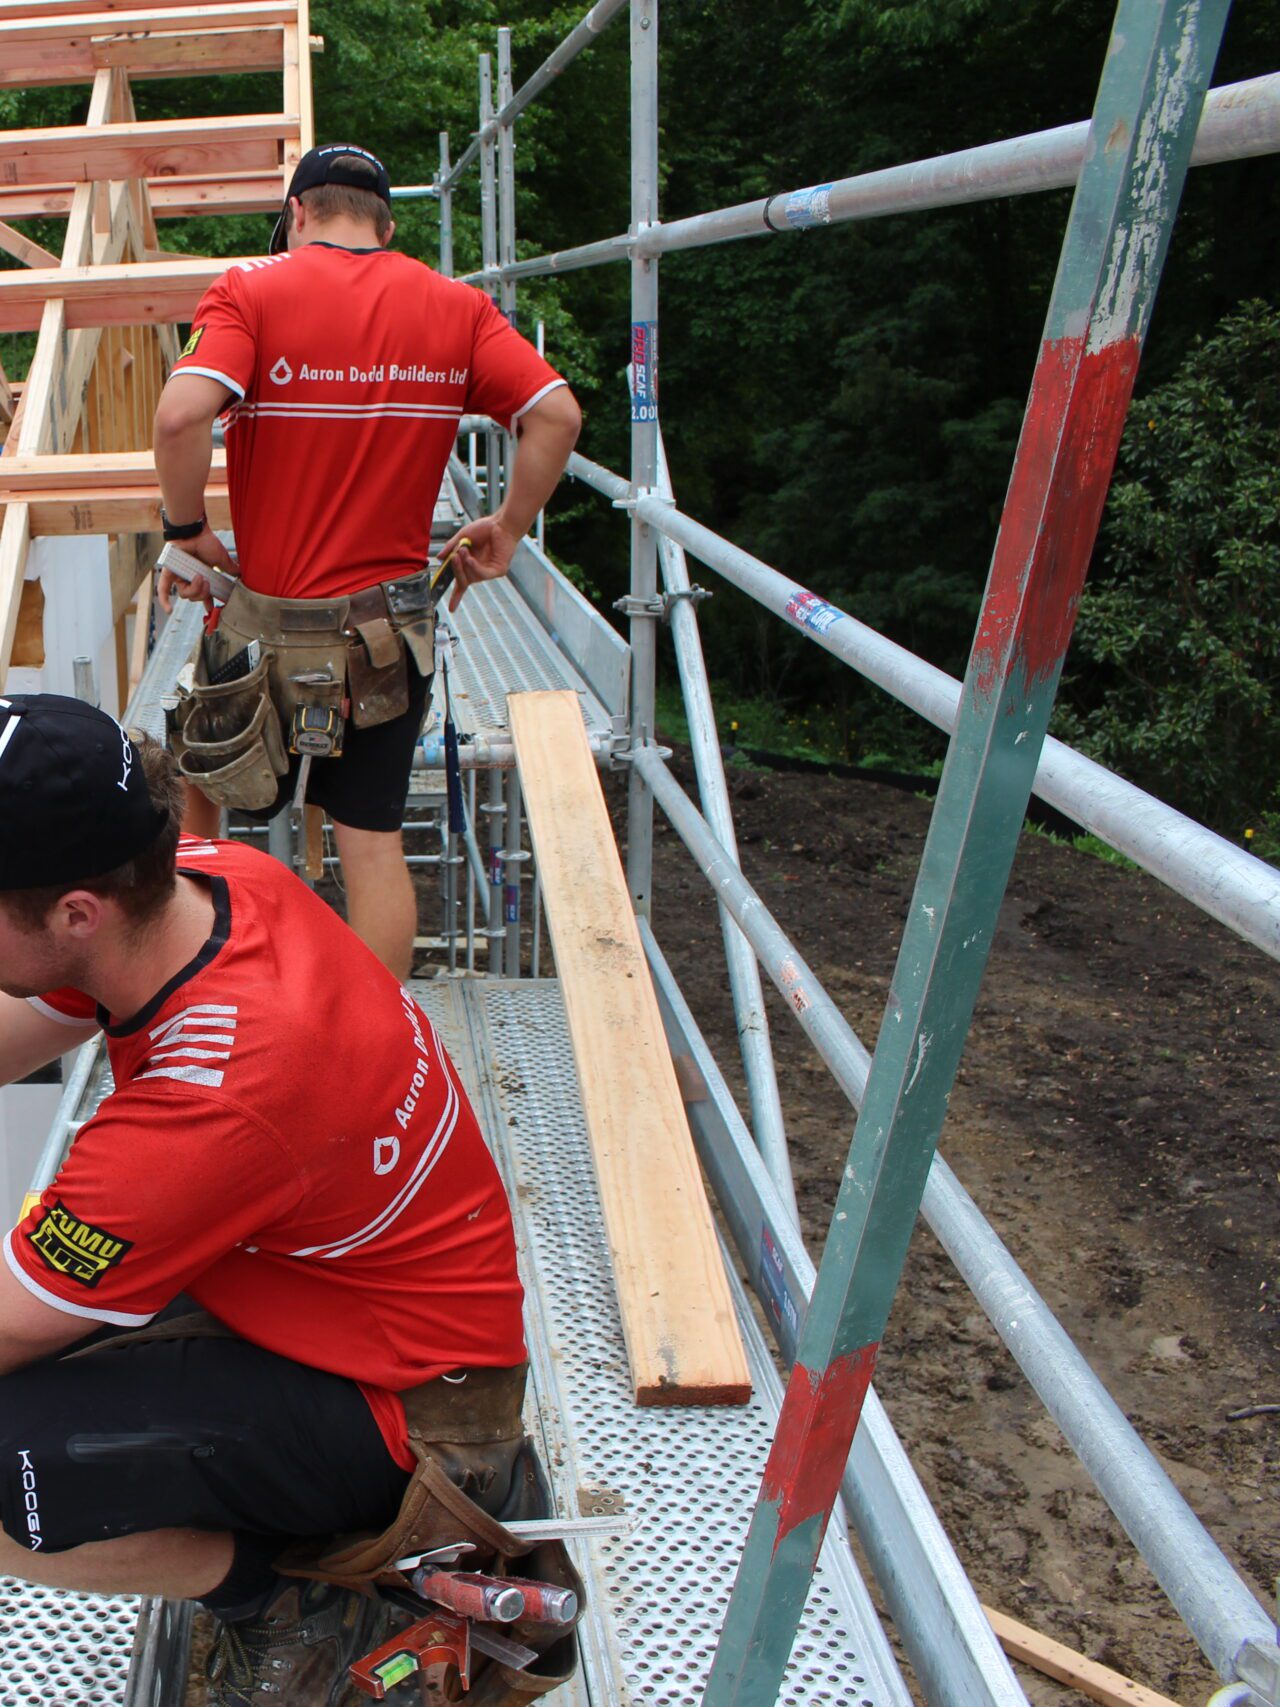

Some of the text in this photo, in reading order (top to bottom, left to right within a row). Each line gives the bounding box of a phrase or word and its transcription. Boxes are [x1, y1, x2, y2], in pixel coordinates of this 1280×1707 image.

[299, 364, 468, 385] Aaron Dodd Builders Ltd
[394, 1057, 430, 1130] Aaron
[17, 1449, 43, 1551] KOOGA
